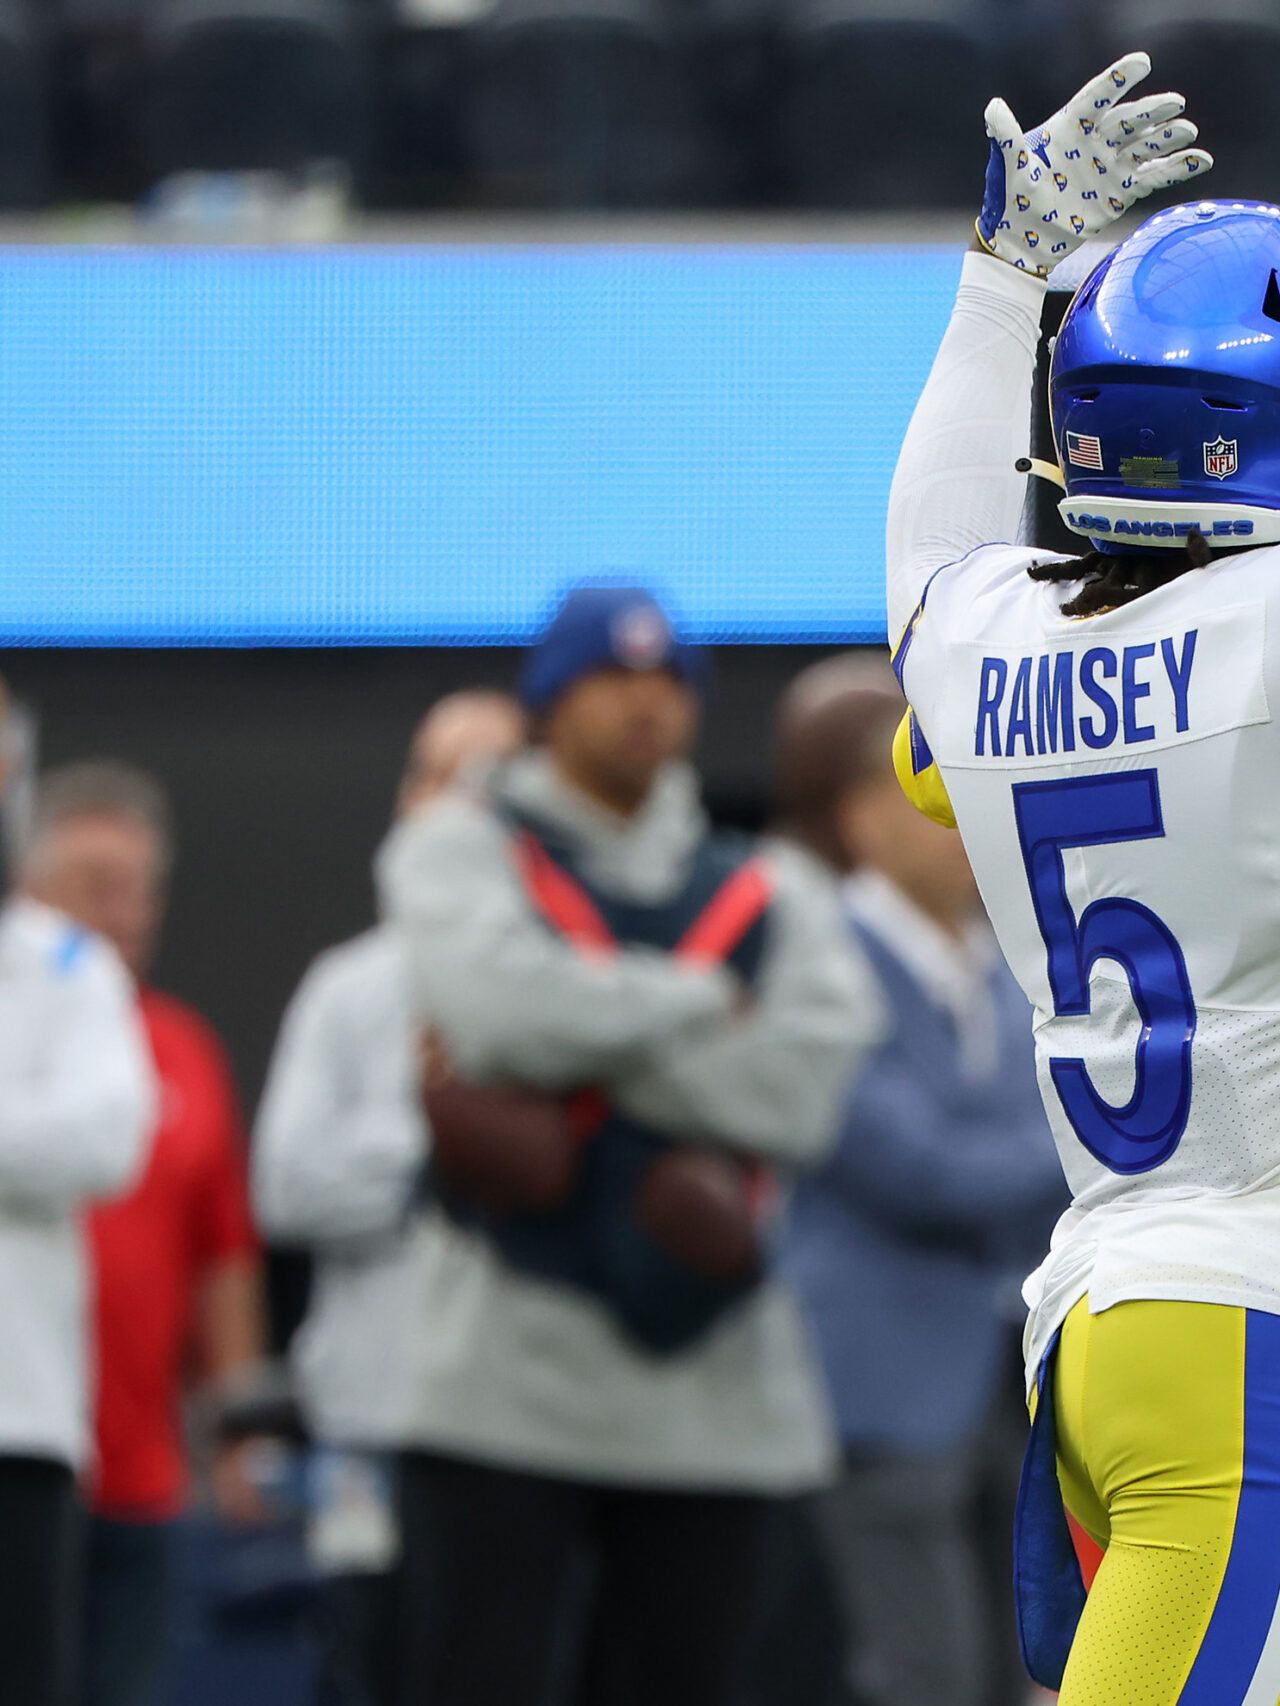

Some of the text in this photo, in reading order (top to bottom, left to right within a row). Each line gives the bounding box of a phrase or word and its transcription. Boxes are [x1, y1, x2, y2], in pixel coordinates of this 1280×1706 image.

[1208, 454, 1234, 474] NFL
[1067, 512, 1253, 536] LOS ANGELES
[974, 628, 1199, 758] RAMSEY
[1011, 767, 1197, 1176] 5
